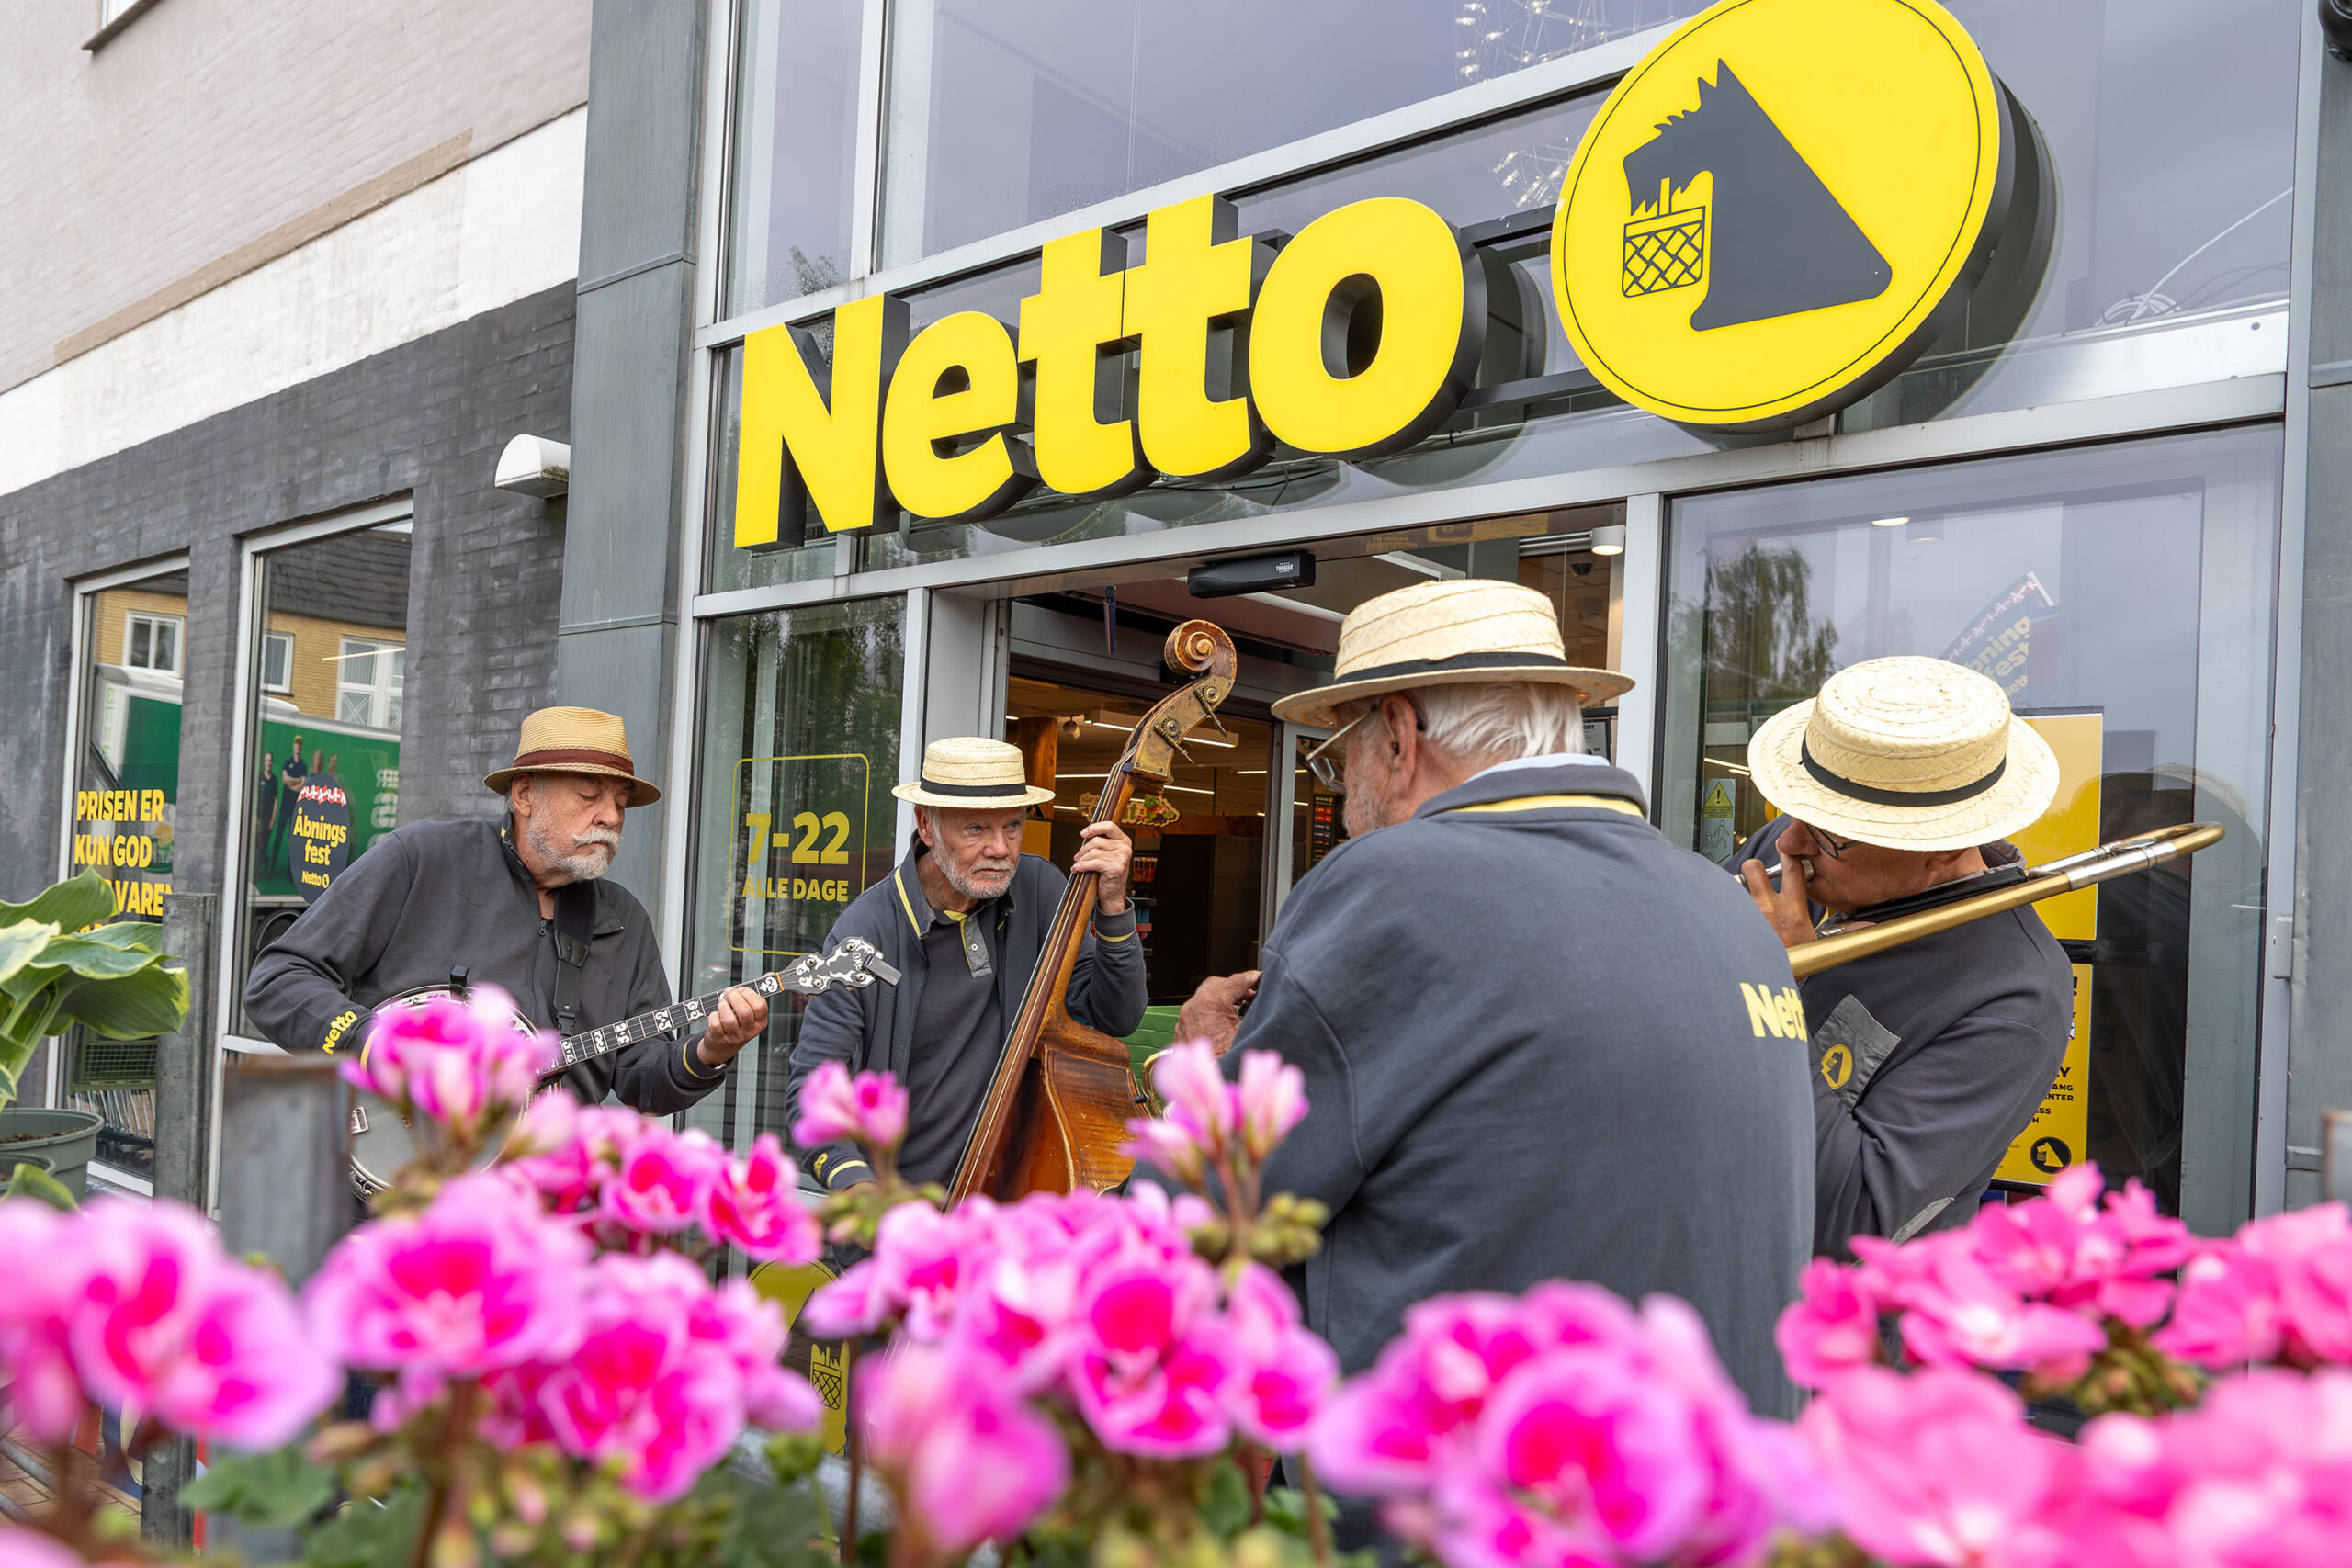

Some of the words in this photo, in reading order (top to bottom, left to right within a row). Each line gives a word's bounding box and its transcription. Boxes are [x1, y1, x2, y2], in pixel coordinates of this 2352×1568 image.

[734, 194, 1465, 549] Netto
[76, 789, 138, 822] PRISEN
[140, 789, 165, 822] ER
[293, 807, 347, 848] Åbnings
[745, 810, 850, 865] 7-22
[74, 834, 111, 866] KUN
[112, 834, 153, 868] GOD
[304, 839, 331, 866] fest
[301, 870, 322, 887] Netto
[741, 877, 789, 899] ALLE
[793, 878, 849, 902] DAGE
[115, 880, 173, 917] VARE
[1739, 982, 1808, 1043] Nett
[322, 1010, 357, 1055] Netto
